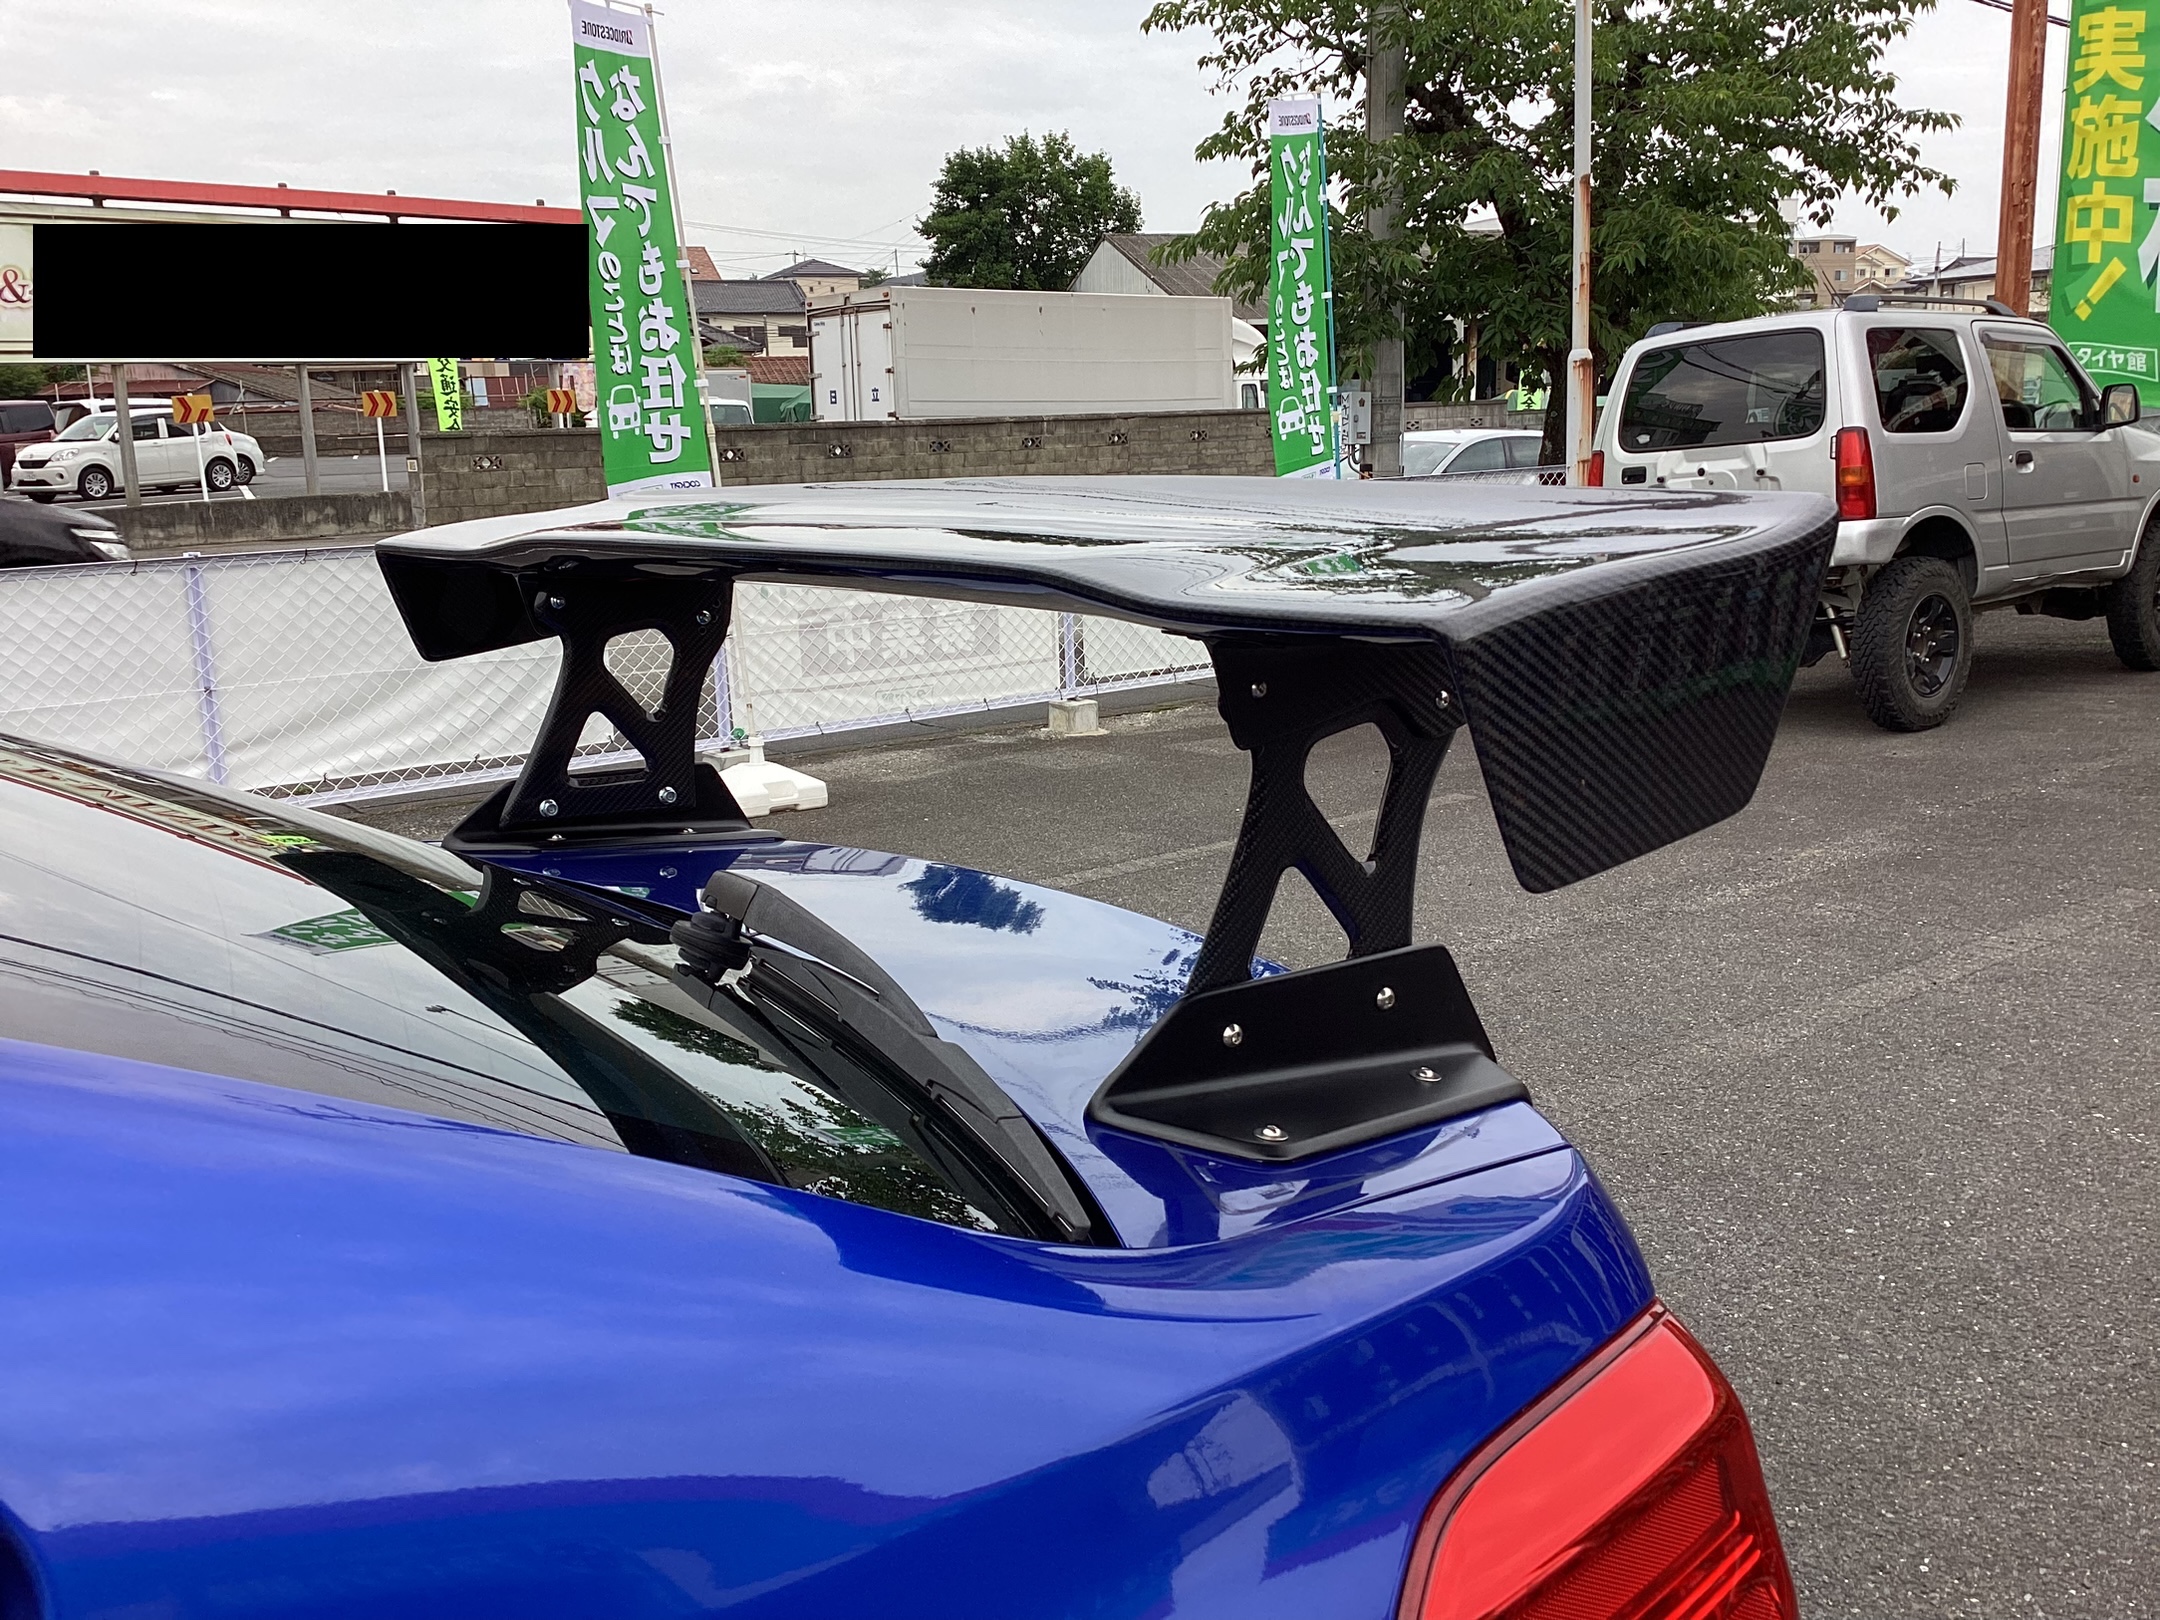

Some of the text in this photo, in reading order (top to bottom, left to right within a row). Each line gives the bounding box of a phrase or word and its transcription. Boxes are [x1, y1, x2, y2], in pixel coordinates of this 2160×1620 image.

[2063, 6, 2146, 321] 実施中!
[2076, 348, 2147, 372] タイヤ館
